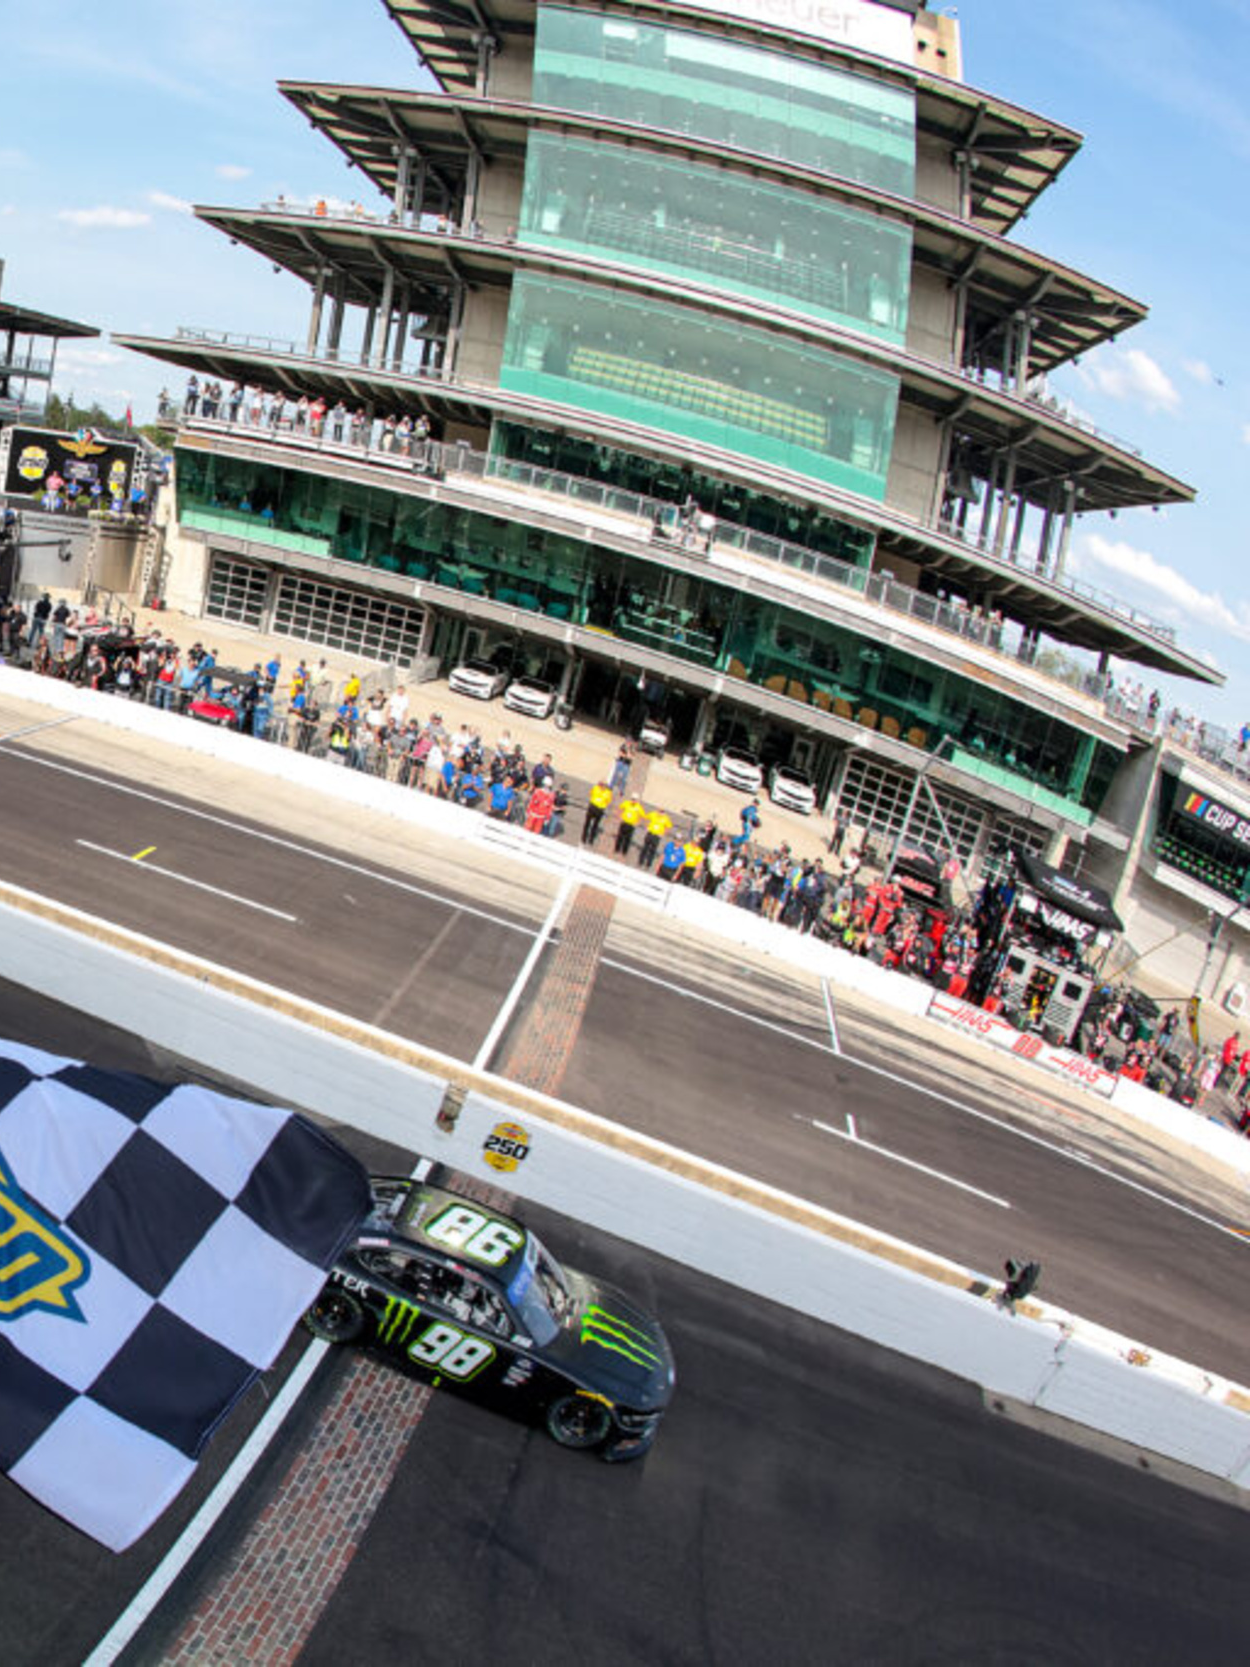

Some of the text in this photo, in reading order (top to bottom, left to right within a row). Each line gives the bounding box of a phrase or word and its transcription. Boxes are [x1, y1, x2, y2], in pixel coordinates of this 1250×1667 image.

[736, 0, 860, 35] euer
[1204, 804, 1238, 831] CUP
[482, 1134, 530, 1161] 250
[409, 1322, 494, 1378] 98
